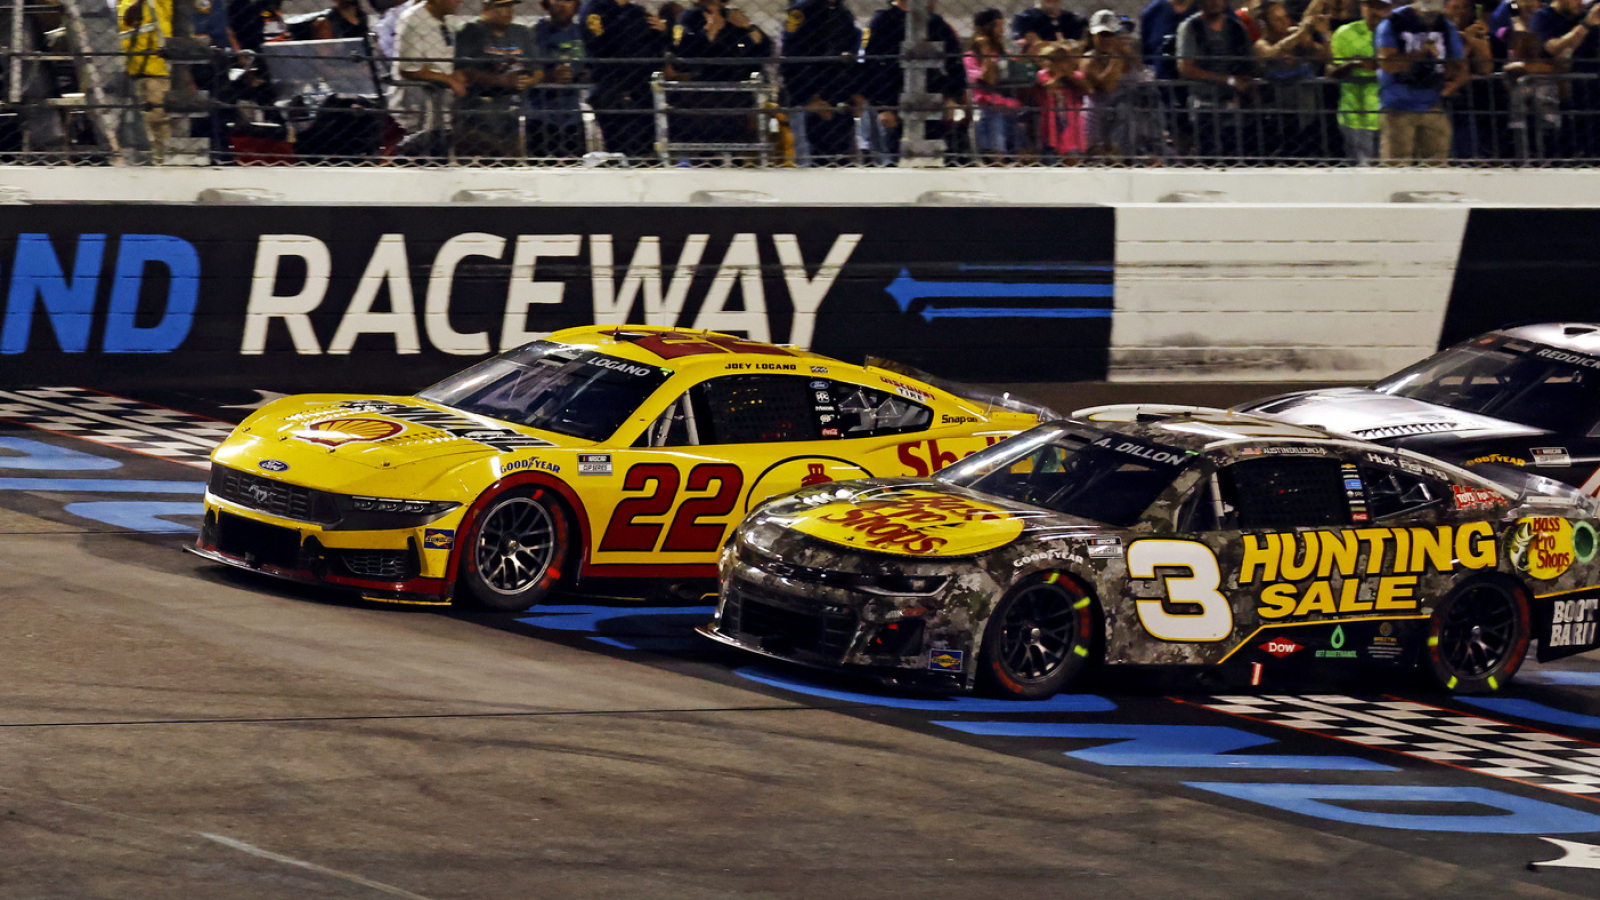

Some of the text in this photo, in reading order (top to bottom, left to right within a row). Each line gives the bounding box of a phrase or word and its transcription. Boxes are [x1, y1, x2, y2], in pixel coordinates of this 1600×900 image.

[240, 231, 863, 355] RACEWAY
[587, 356, 651, 377] LOGANO
[898, 387, 924, 401] TIRE
[1094, 437, 1185, 466] A. DILLON
[1464, 453, 1526, 467] OODYEAR
[261, 460, 284, 471] Ford
[500, 457, 561, 474] GOODYEAR
[597, 462, 744, 552] 22
[1532, 517, 1561, 532] Bass
[1238, 521, 1498, 584] HUNTING
[1534, 534, 1556, 550] Pro
[1013, 551, 1084, 567] GOODYEAR
[1536, 548, 1570, 573] Shops
[1127, 539, 1234, 642] 3
[1257, 575, 1418, 619] SALE
[1552, 598, 1599, 623] BOOT
